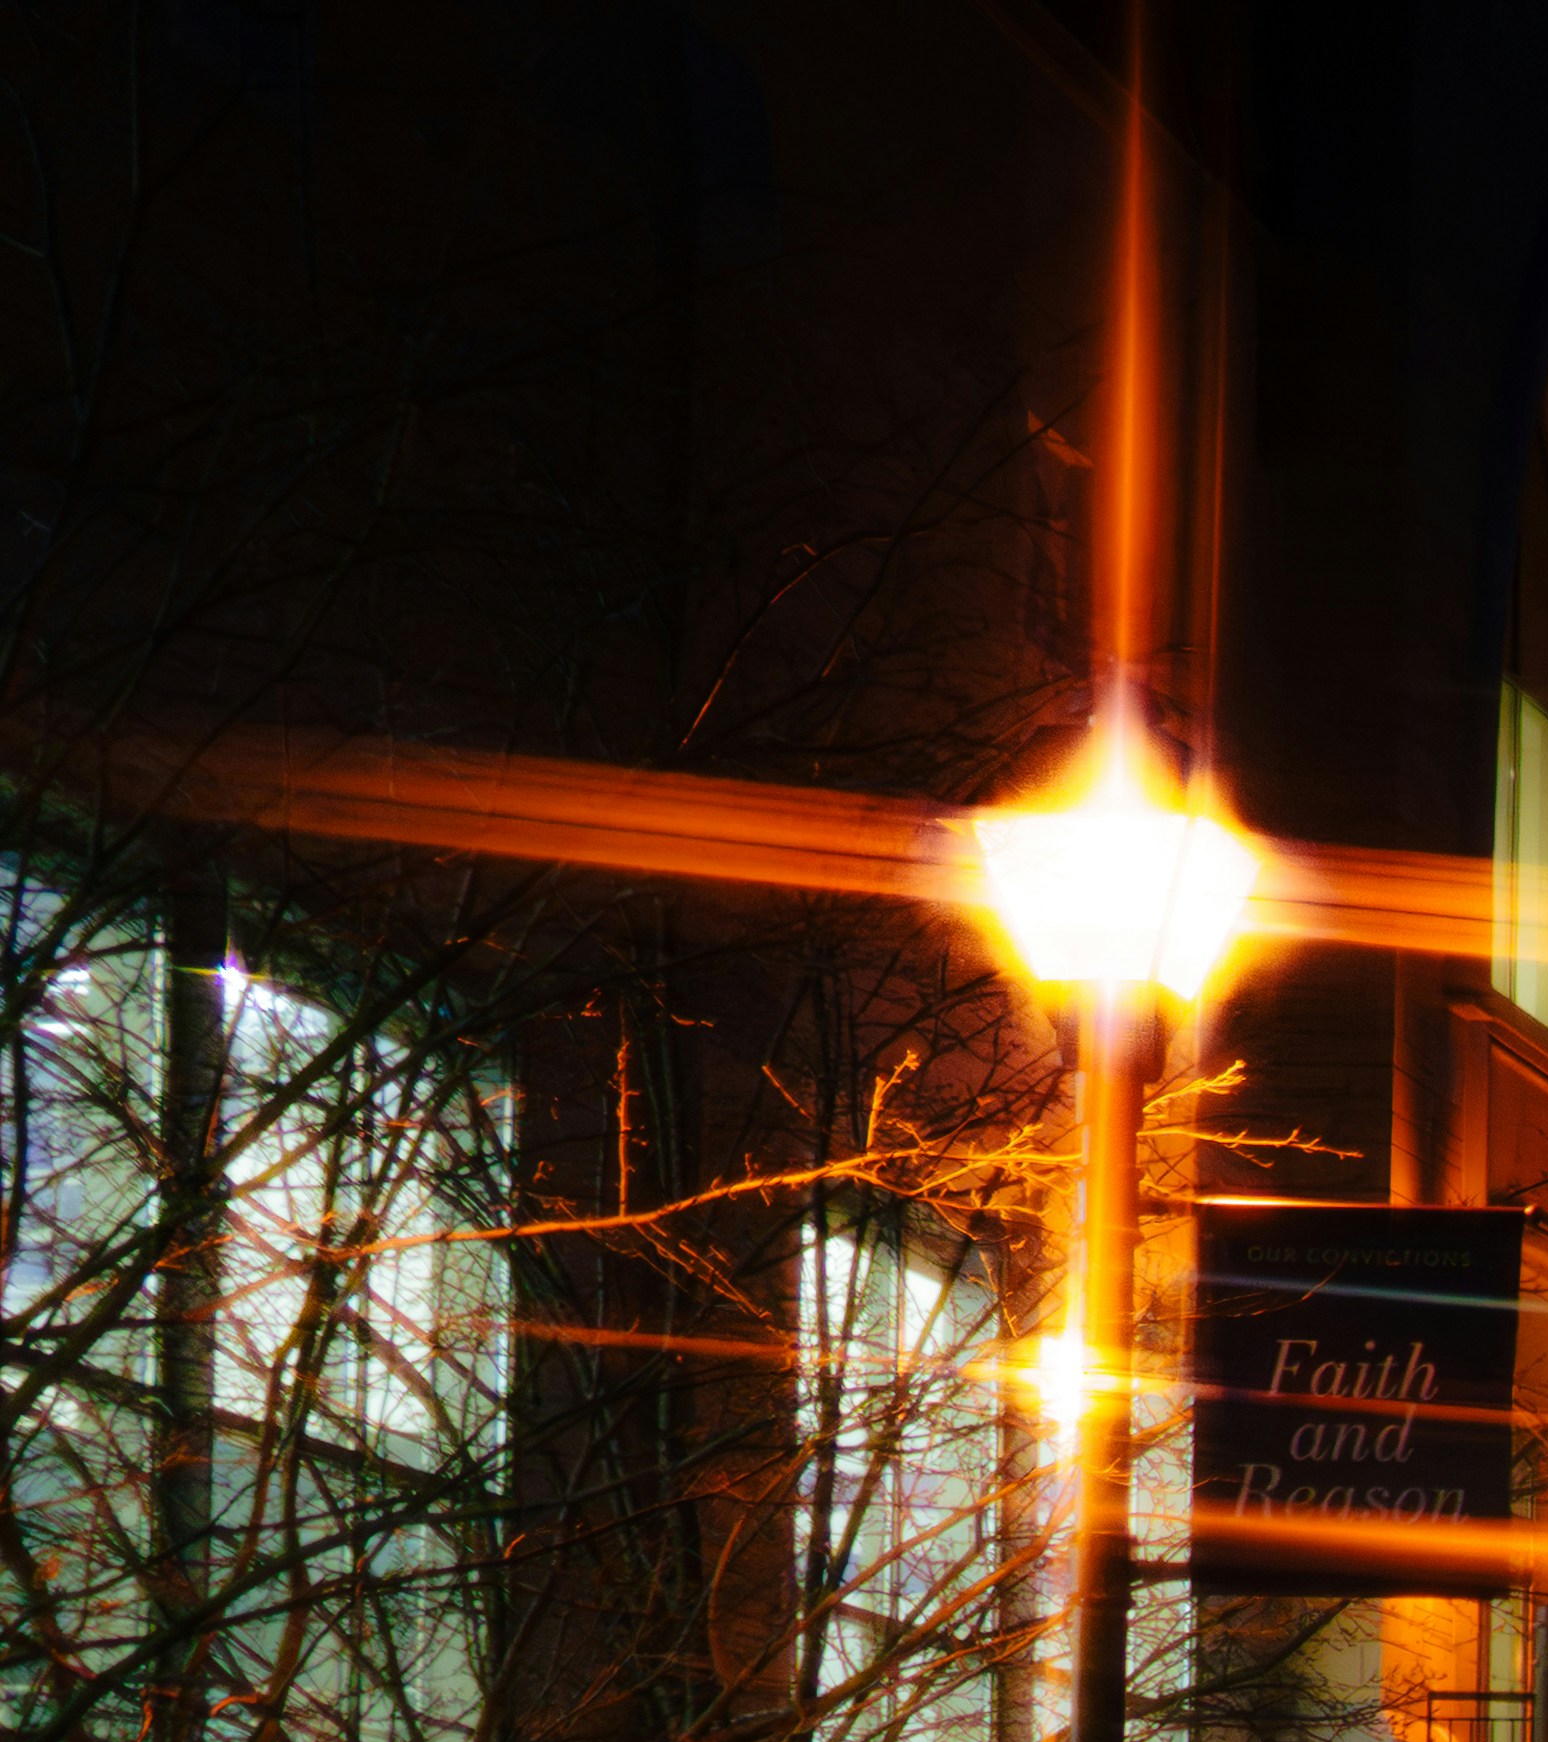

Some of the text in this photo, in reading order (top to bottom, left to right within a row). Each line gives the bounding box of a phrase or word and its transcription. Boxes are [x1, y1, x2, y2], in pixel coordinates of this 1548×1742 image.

[1246, 1244, 1473, 1268] OUR CONVICTIONS
[1267, 1338, 1440, 1401] Faith
[1288, 1404, 1417, 1464] and
[1233, 1462, 1472, 1525] Reason
